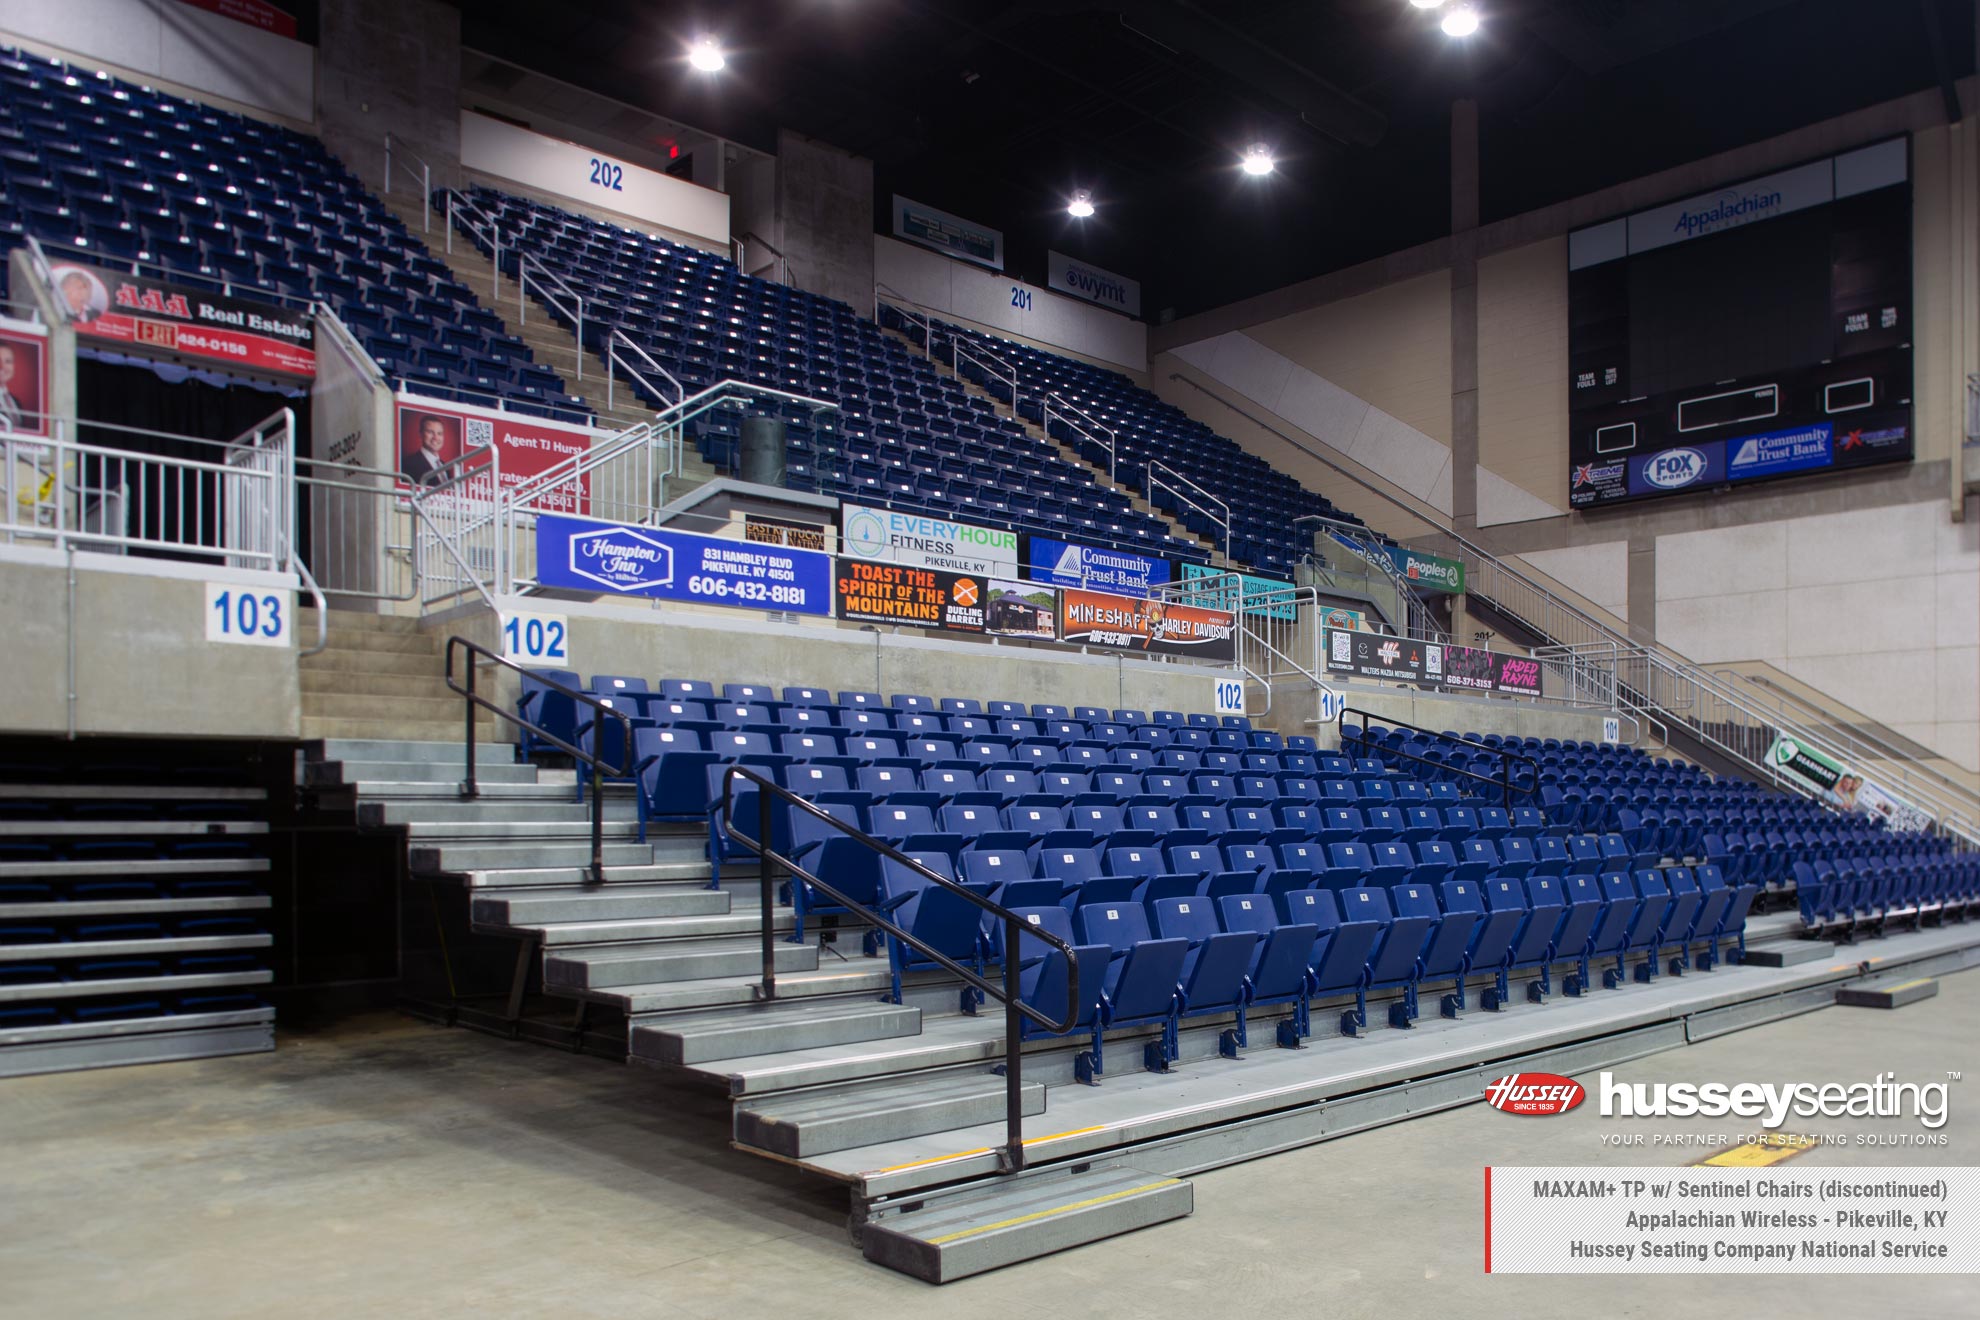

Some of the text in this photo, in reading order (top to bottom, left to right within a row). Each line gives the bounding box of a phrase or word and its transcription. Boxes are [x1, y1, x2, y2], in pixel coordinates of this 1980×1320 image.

[590, 158, 623, 191] 202
[1673, 192, 1781, 235] Appalachian
[1011, 287, 1032, 311] 201
[1078, 274, 1126, 304] wymt
[116, 283, 193, 319] AAA
[199, 303, 311, 340] Real Estate
[1845, 322, 1869, 333] FOULS
[1848, 313, 1868, 324] TEAM
[144, 323, 173, 346] EXIT
[1577, 379, 1596, 389] FOULS
[1578, 372, 1594, 381] TEAM
[504, 432, 583, 455] Agent TJ Hurst
[1758, 428, 1829, 449] Community
[1758, 440, 1827, 462] Trust Bank
[1656, 454, 1693, 476] FOX
[1656, 471, 1693, 482] SPORTS
[890, 514, 1016, 550] EVERYHOUR
[582, 539, 662, 563] Hampton
[891, 534, 954, 554] FITNESS
[601, 557, 644, 575] Inn
[704, 548, 793, 569] 831 HAMBLEY BLVD
[925, 556, 985, 572] PIKEVILLE, KY
[1082, 548, 1152, 576] Community
[753, 566, 766, 578] KY
[768, 568, 795, 581] 41501
[851, 563, 935, 587] TOAST THE
[1082, 565, 1149, 589] Trust Bank
[688, 575, 805, 605] 606-432-8181
[839, 578, 945, 604] SPIRIT OF THE
[215, 591, 282, 638] 103
[846, 596, 939, 620] MOUNTAINS
[947, 605, 983, 617] DUELING
[1069, 603, 1150, 631] MINESHAFT
[946, 614, 984, 626] BARRELS
[1163, 617, 1231, 640] HARLEY DAVIDSON
[505, 617, 565, 658] 102
[1361, 666, 1380, 675] WALTERS
[1380, 668, 1393, 677] MAZDA
[1502, 659, 1539, 674] JADED
[1447, 675, 1492, 688] 606-371-3153
[1501, 671, 1537, 686] RAYNE
[1217, 681, 1242, 709] 102
[1606, 720, 1618, 741] 101
